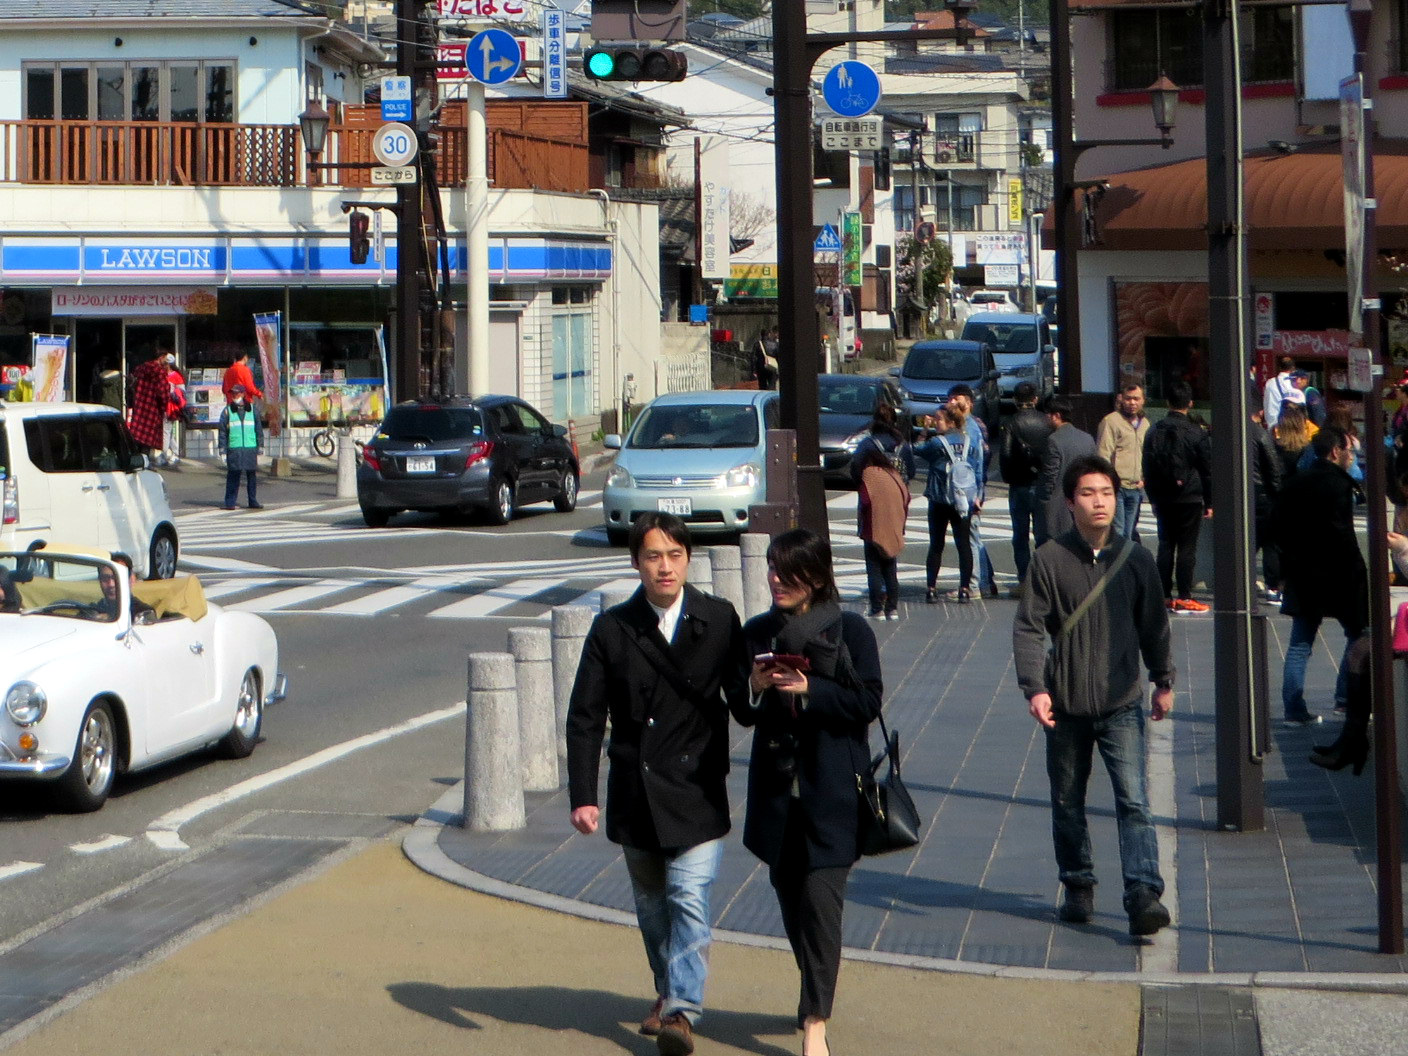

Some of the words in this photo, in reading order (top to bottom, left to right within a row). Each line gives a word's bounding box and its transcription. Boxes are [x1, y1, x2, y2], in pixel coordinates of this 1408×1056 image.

[547, 13, 561, 93] 歩車分離信号
[384, 104, 407, 112] POLICE
[825, 121, 877, 133] 自転車通行可
[384, 135, 408, 155] 30
[826, 136, 877, 147] ここまで
[374, 170, 414, 181] ここから
[101, 248, 211, 268] LAWSON
